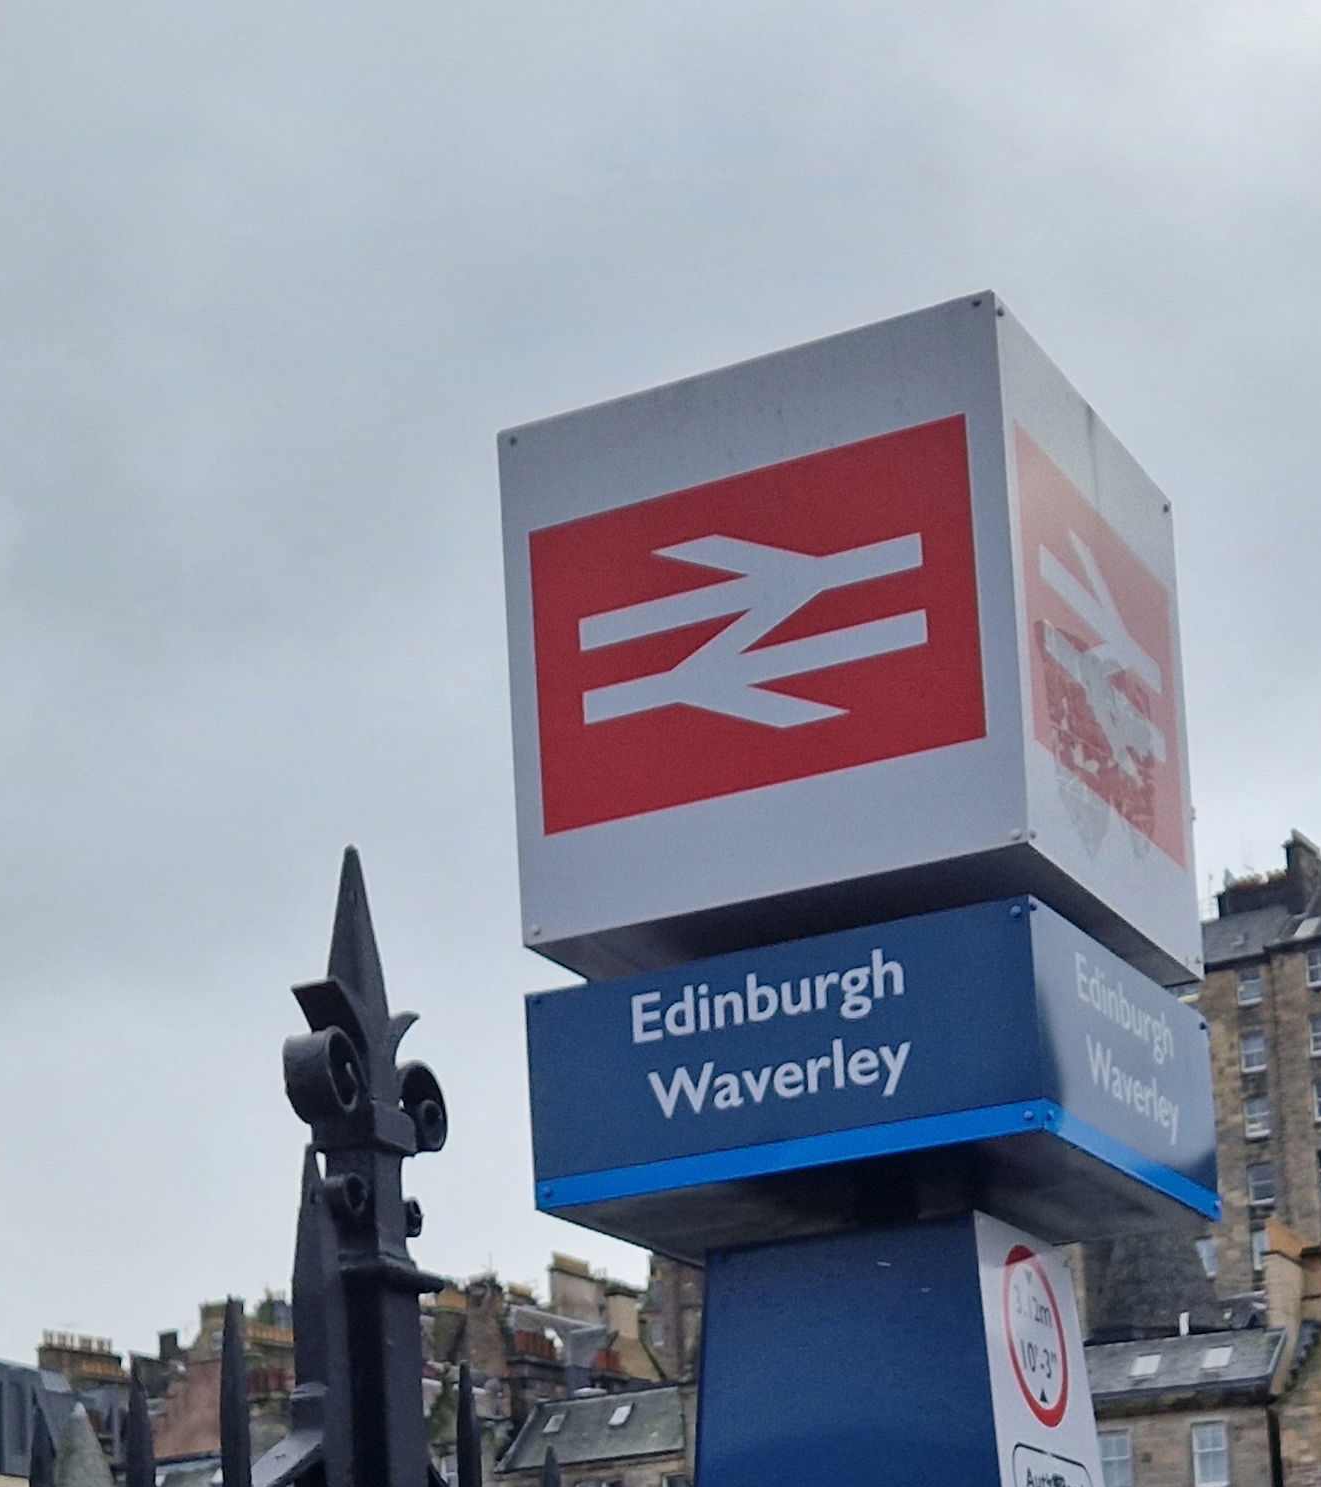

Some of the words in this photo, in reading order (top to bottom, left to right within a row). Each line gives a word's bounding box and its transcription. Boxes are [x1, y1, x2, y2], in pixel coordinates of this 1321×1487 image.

[631, 948, 905, 1044] Edinburgh
[1074, 952, 1174, 1065] Edinburgh
[647, 1037, 911, 1119] Waverley
[1085, 1034, 1178, 1146] Waverley
